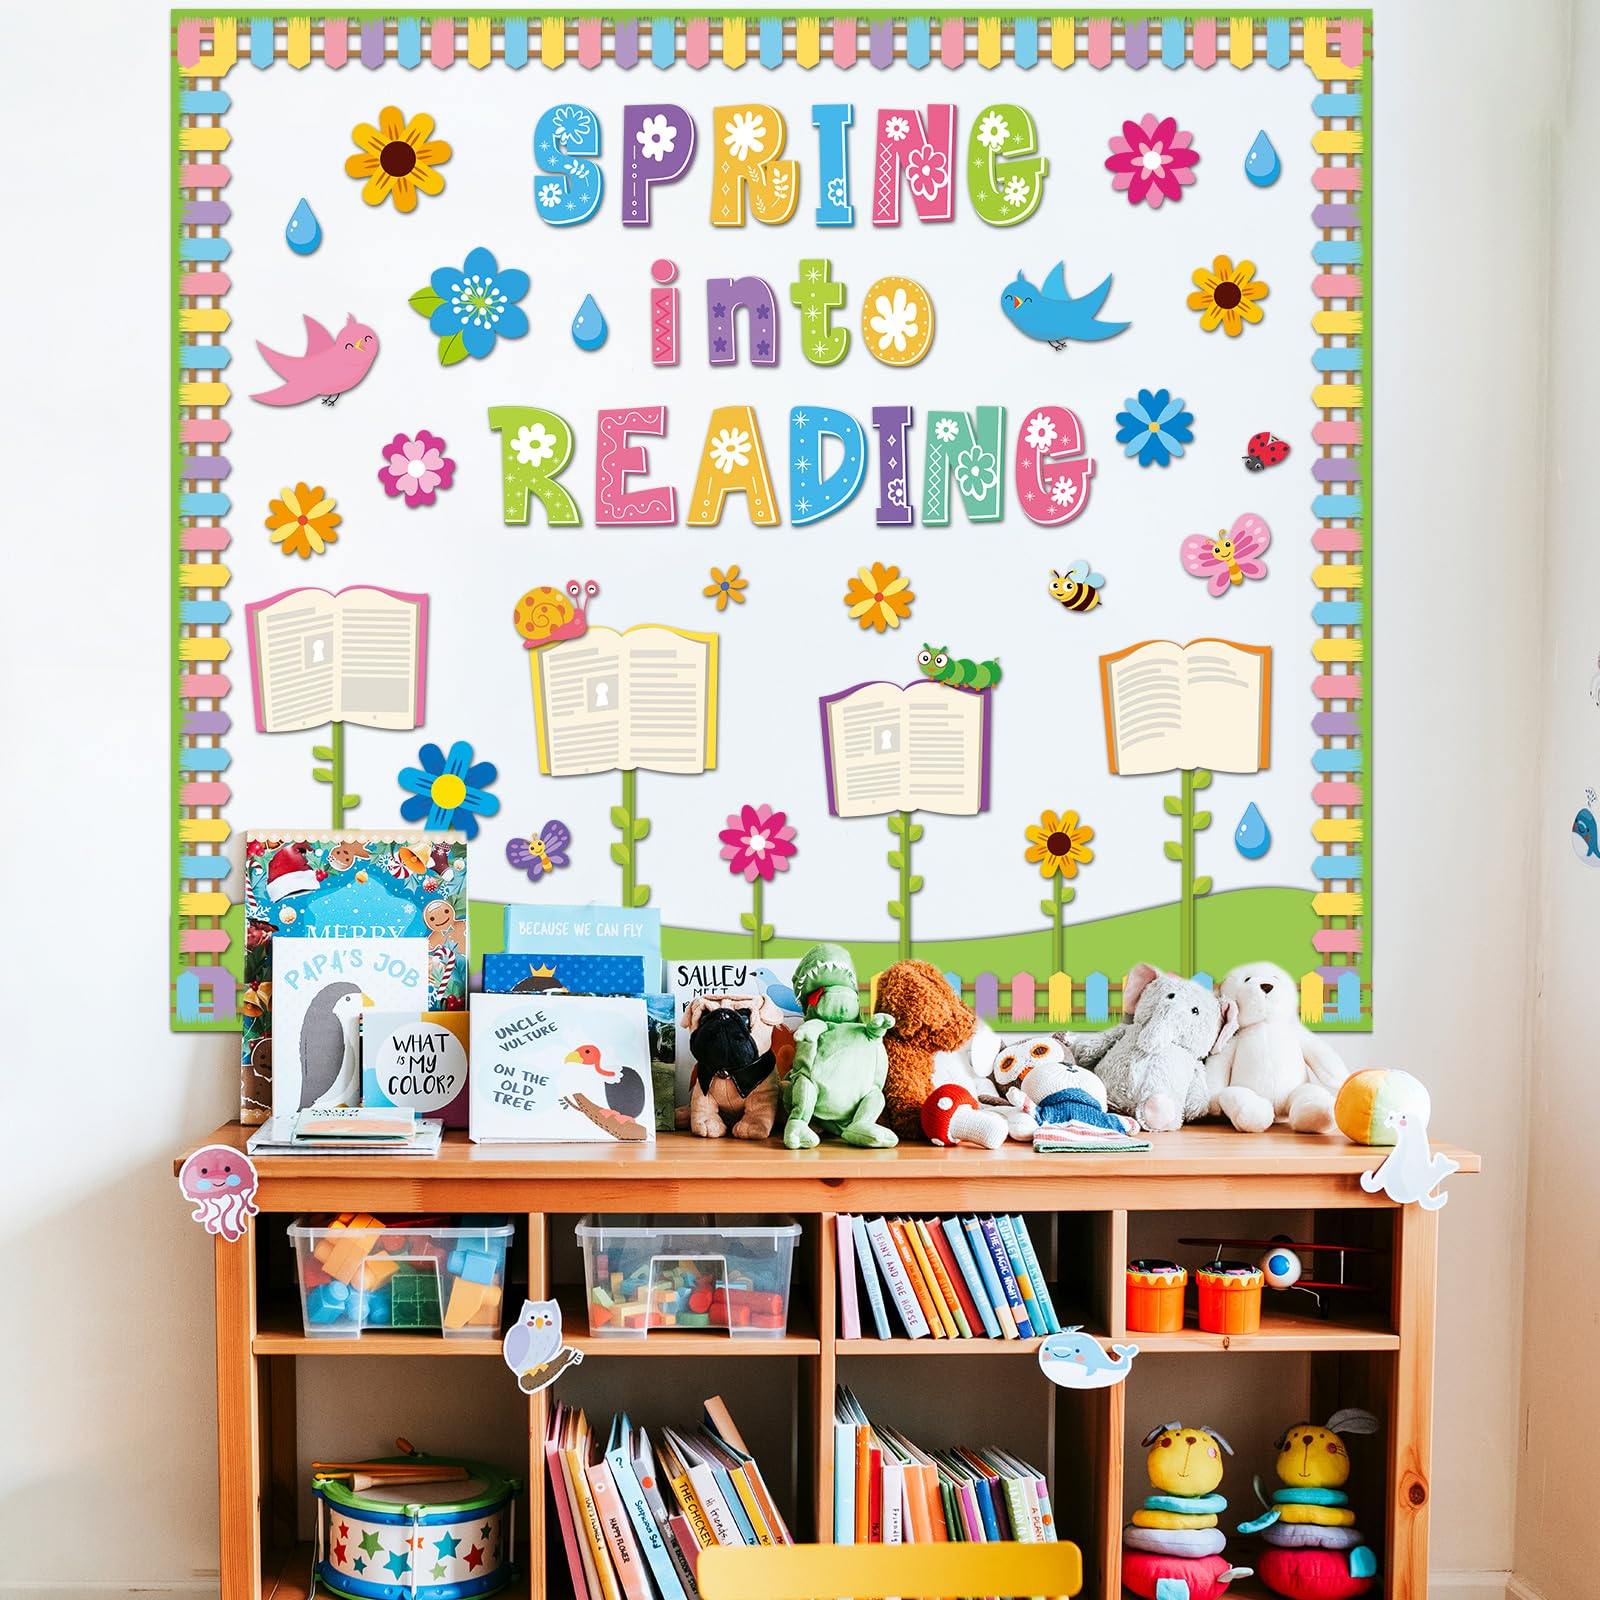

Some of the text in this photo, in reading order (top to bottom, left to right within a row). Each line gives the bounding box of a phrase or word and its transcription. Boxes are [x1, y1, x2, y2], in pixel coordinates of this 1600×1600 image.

[533, 102, 1049, 227] SPRING
[649, 257, 936, 368] into
[487, 404, 1096, 528] READING
[518, 921, 644, 938] BECAUSE WE CAN FLY
[283, 948, 420, 990] PAPA'S JOB
[677, 965, 748, 987] SALLEY
[494, 1010, 548, 1040] UNCLE
[499, 1021, 559, 1052] VULTURE
[392, 1033, 450, 1053] WHAT
[409, 1054, 437, 1073] MY
[493, 1063, 551, 1087] ON THE
[388, 1074, 455, 1095] COLOR?
[500, 1079, 534, 1096] OLD
[492, 1090, 537, 1111] TREE
[988, 1232, 1000, 1247] THE
[994, 1248, 1009, 1275] MAGIC
[998, 1220, 1019, 1259] SUMMER
[873, 1232, 892, 1258] JENNY
[886, 1261, 900, 1278] AND
[894, 1280, 908, 1296] THE
[901, 1299, 919, 1326] HORSE
[679, 1482, 713, 1547] THE CHICKEN
[610, 1517, 631, 1564] HAPPY FLOWER
